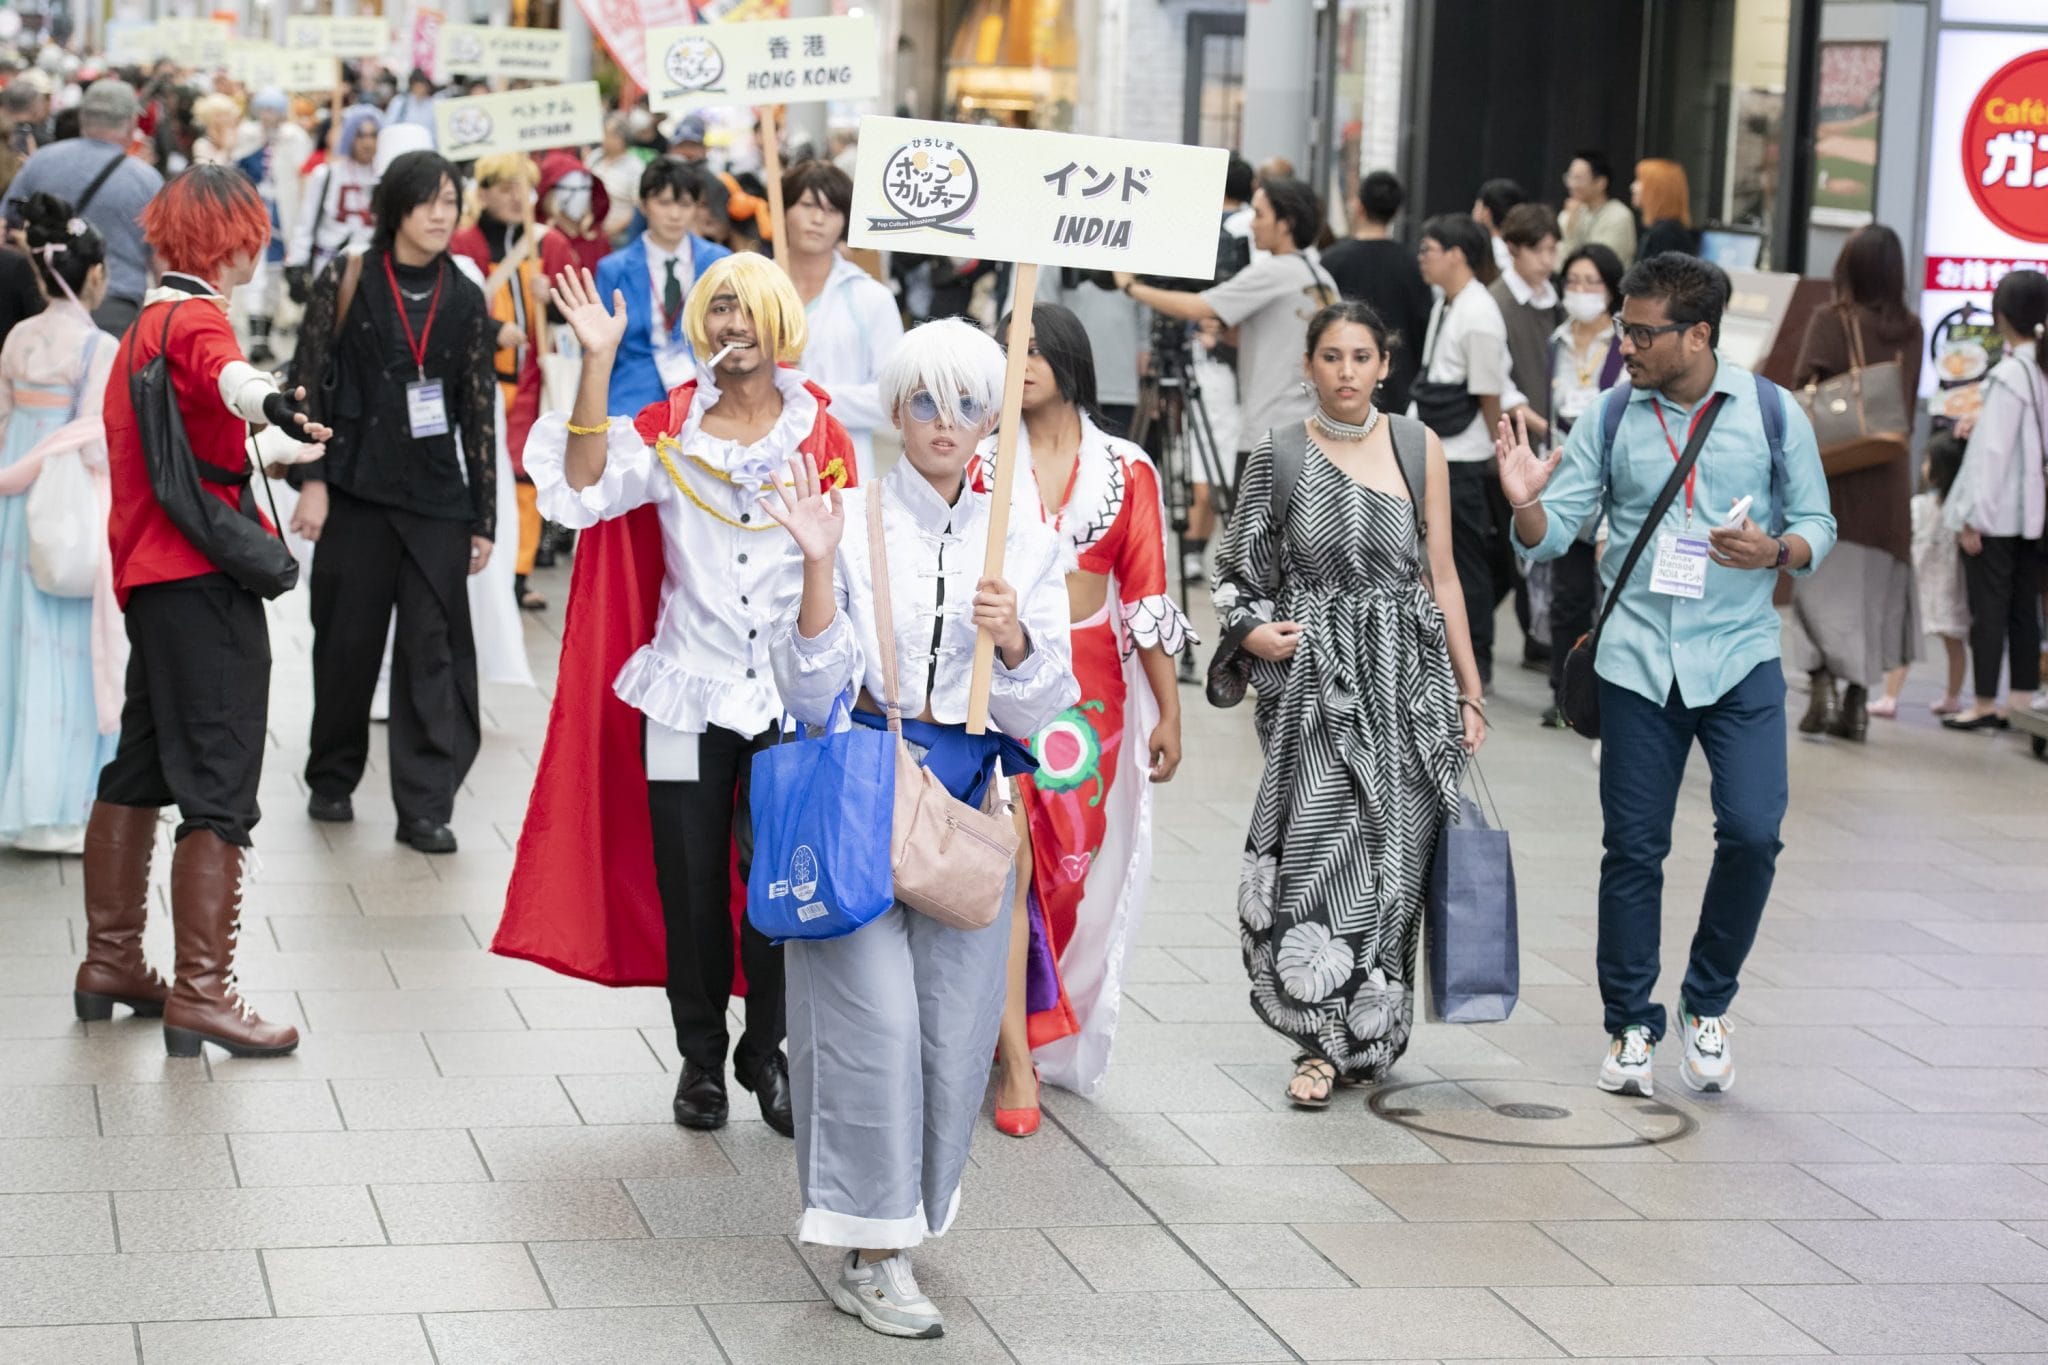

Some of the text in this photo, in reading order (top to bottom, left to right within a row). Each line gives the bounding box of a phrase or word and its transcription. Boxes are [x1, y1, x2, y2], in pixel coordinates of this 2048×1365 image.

[768, 36, 826, 59] 香港
[747, 66, 852, 89] HONG KONG
[1985, 97, 2048, 125] Café
[912, 138, 955, 150] ひろしま
[1982, 130, 2048, 188] ガ
[889, 180, 966, 208] カルチャー
[1043, 161, 1152, 202] インド
[1053, 215, 1132, 248] INDIA
